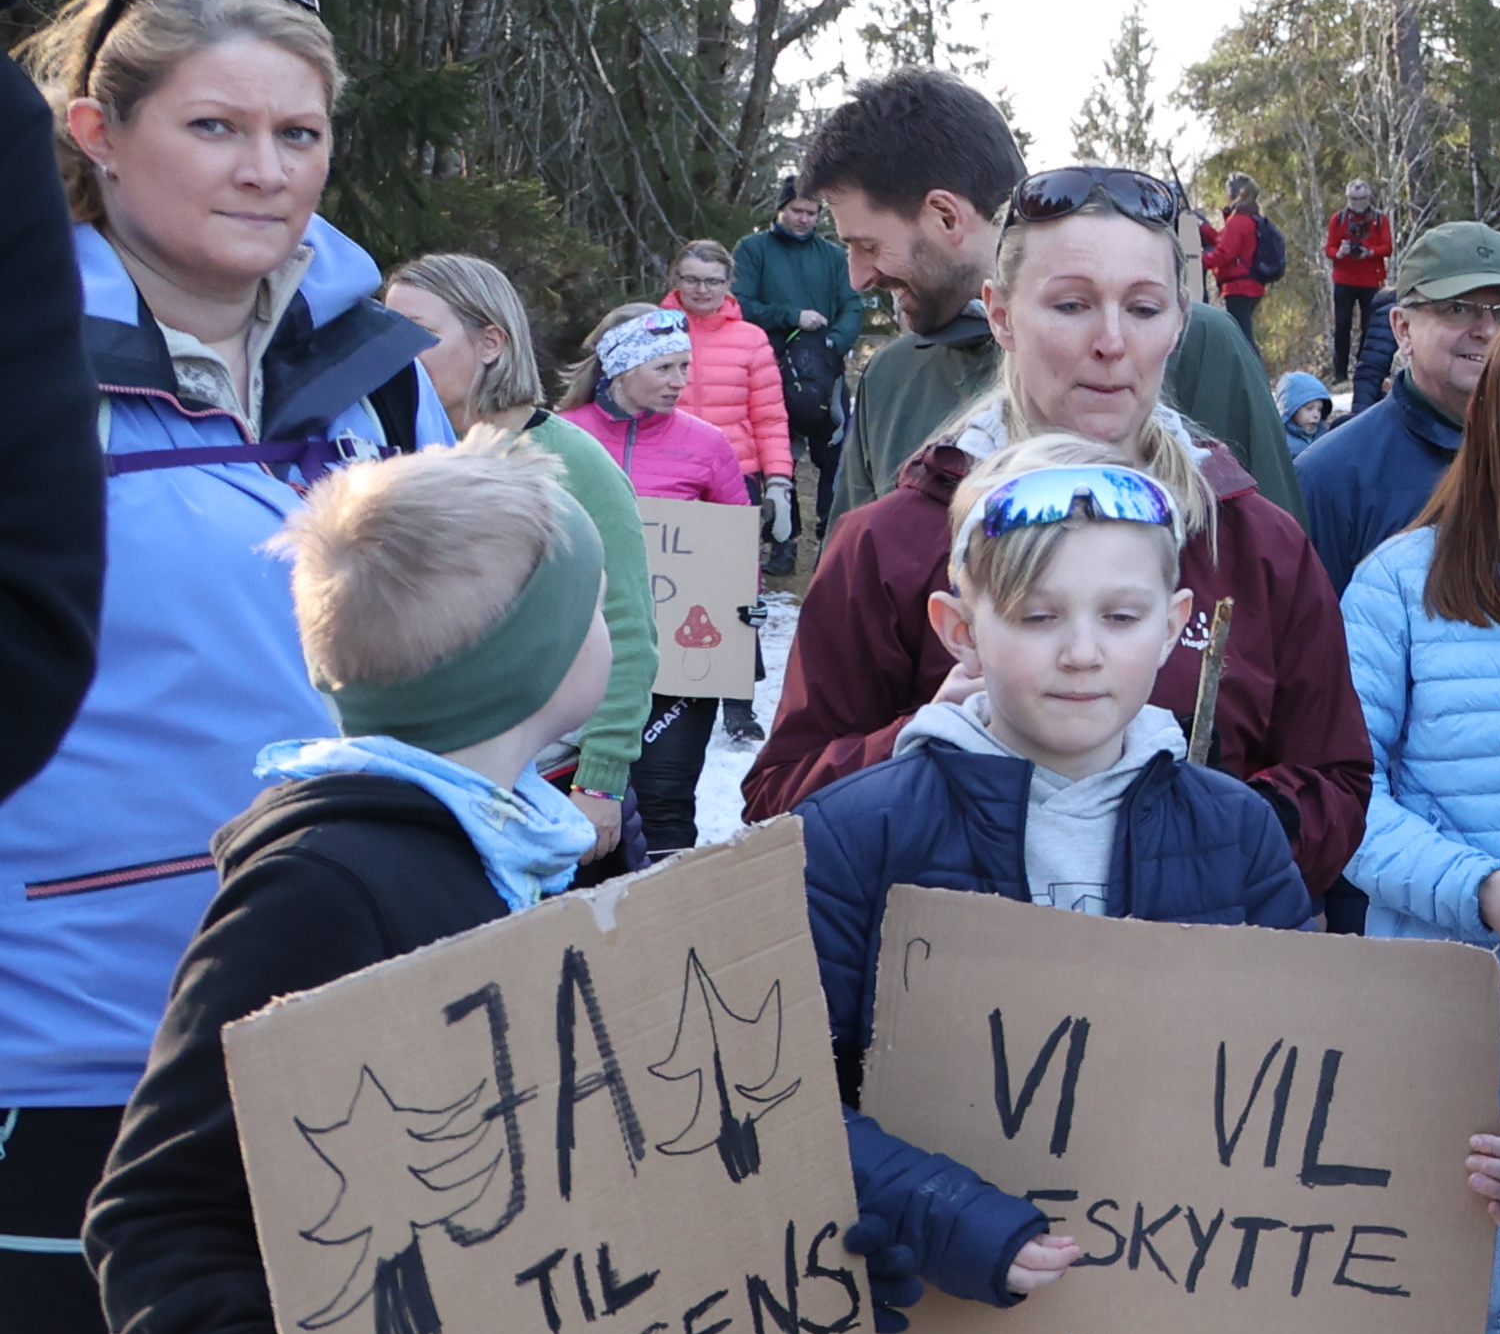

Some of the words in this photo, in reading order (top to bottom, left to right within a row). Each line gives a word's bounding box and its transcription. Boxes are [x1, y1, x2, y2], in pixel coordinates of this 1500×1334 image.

[643, 696, 690, 745] CRAFT
[442, 943, 646, 1248] JA
[987, 1007, 1092, 1159] VI
[1213, 1037, 1392, 1189] VIL
[1024, 1188, 1411, 1299] ESKYTTE
